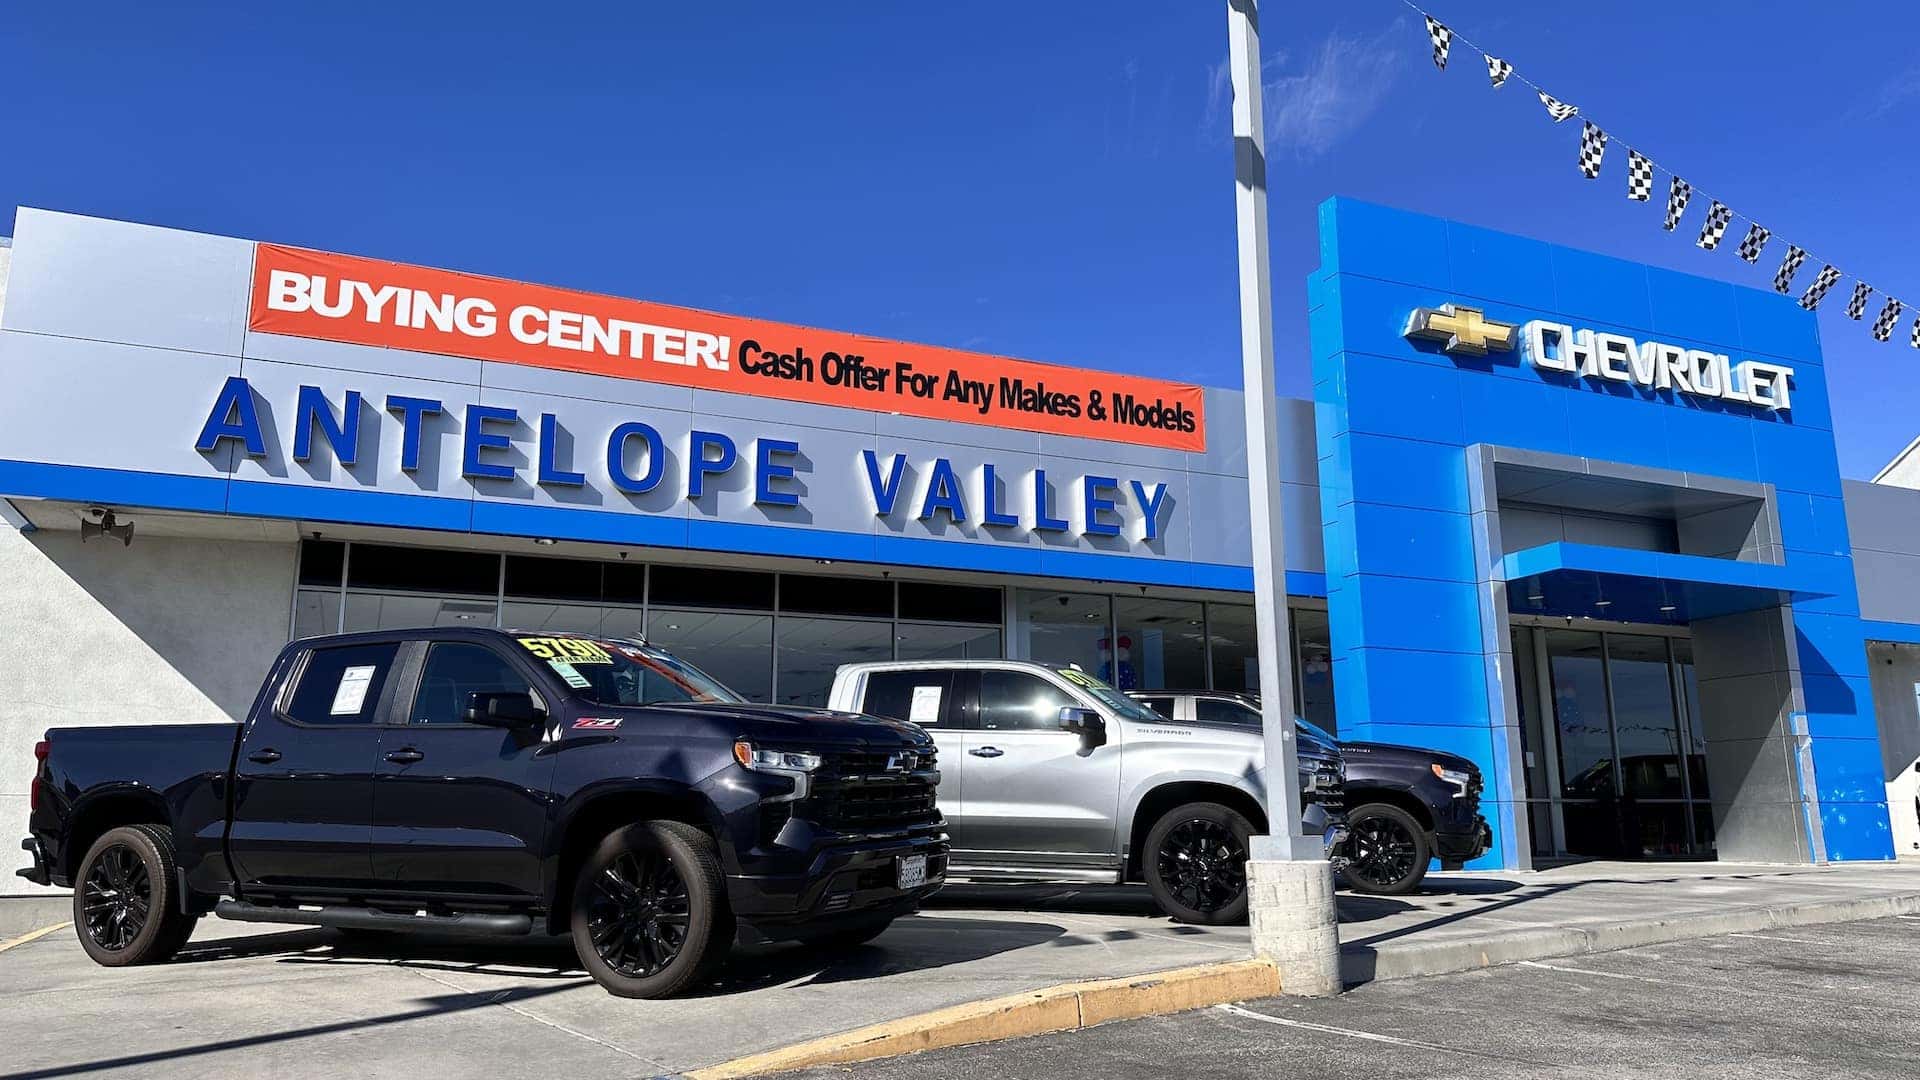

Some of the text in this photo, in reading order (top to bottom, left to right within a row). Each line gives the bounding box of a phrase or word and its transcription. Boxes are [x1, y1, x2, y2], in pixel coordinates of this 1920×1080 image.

[267, 269, 1196, 433] BUYING CENTER! Cash Offer For Any Makes & Models
[1527, 319, 1794, 410] CHEVROLET
[194, 376, 1168, 540] ANTELOPE VALLEY
